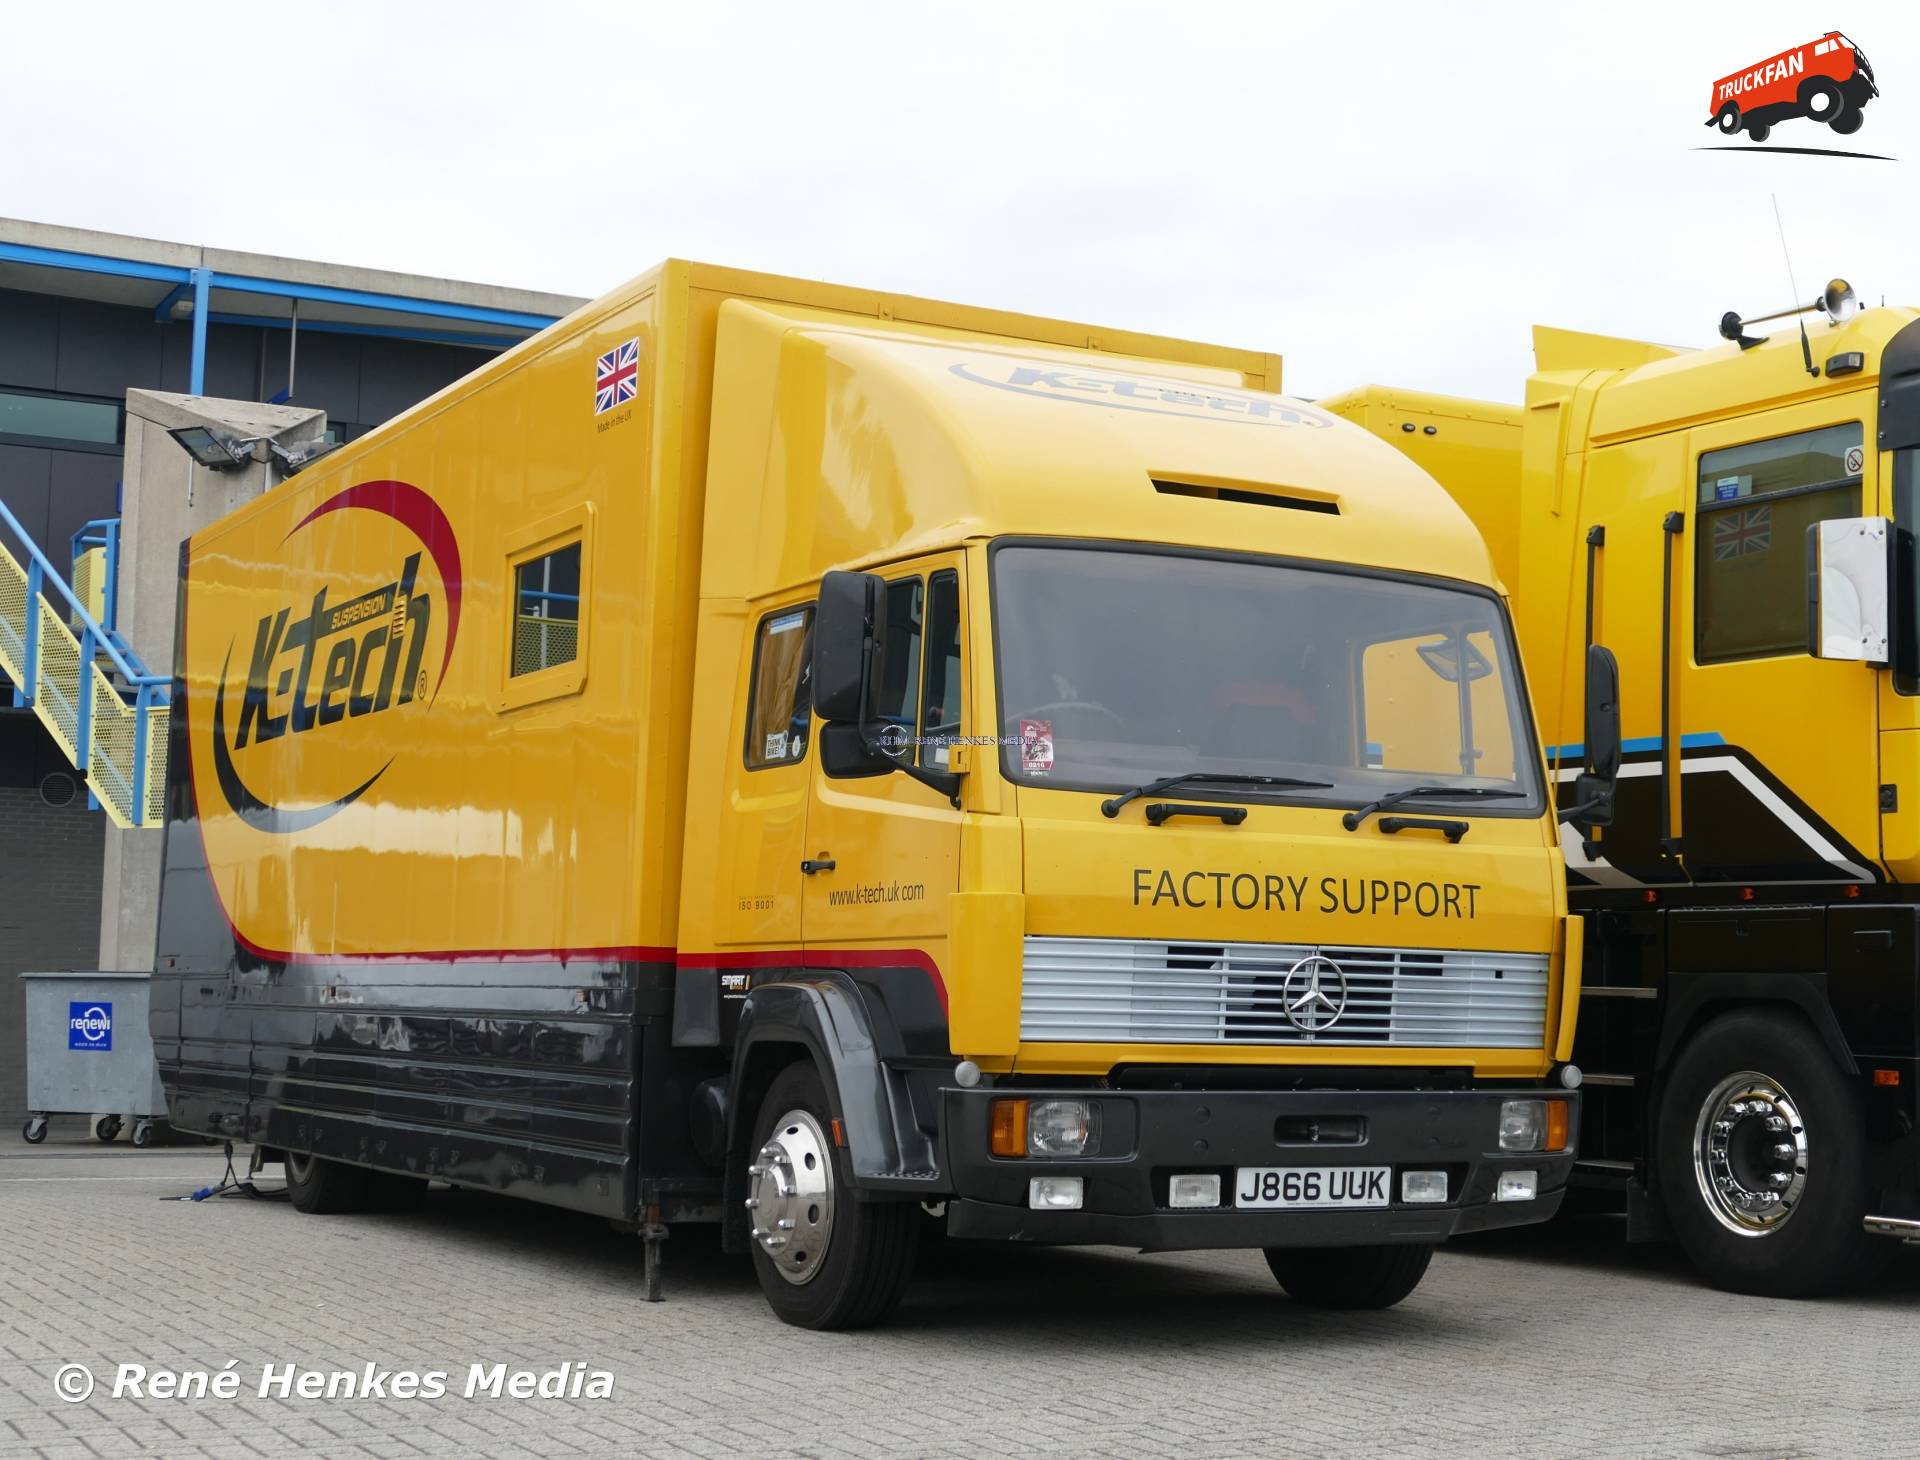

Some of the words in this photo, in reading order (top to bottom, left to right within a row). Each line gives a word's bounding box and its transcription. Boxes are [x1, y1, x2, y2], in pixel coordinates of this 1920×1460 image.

[331, 593, 386, 630] SUSPENSION
[767, 738, 781, 748] THINK
[738, 900, 752, 910] ISO
[755, 900, 774, 910] 9001
[1133, 868, 1308, 912] FACTORY
[1320, 877, 1481, 919] SUPPORT
[71, 1016, 110, 1030] renewi
[1241, 1172, 1322, 1202] J866
[1329, 1170, 1386, 1200] UUK
